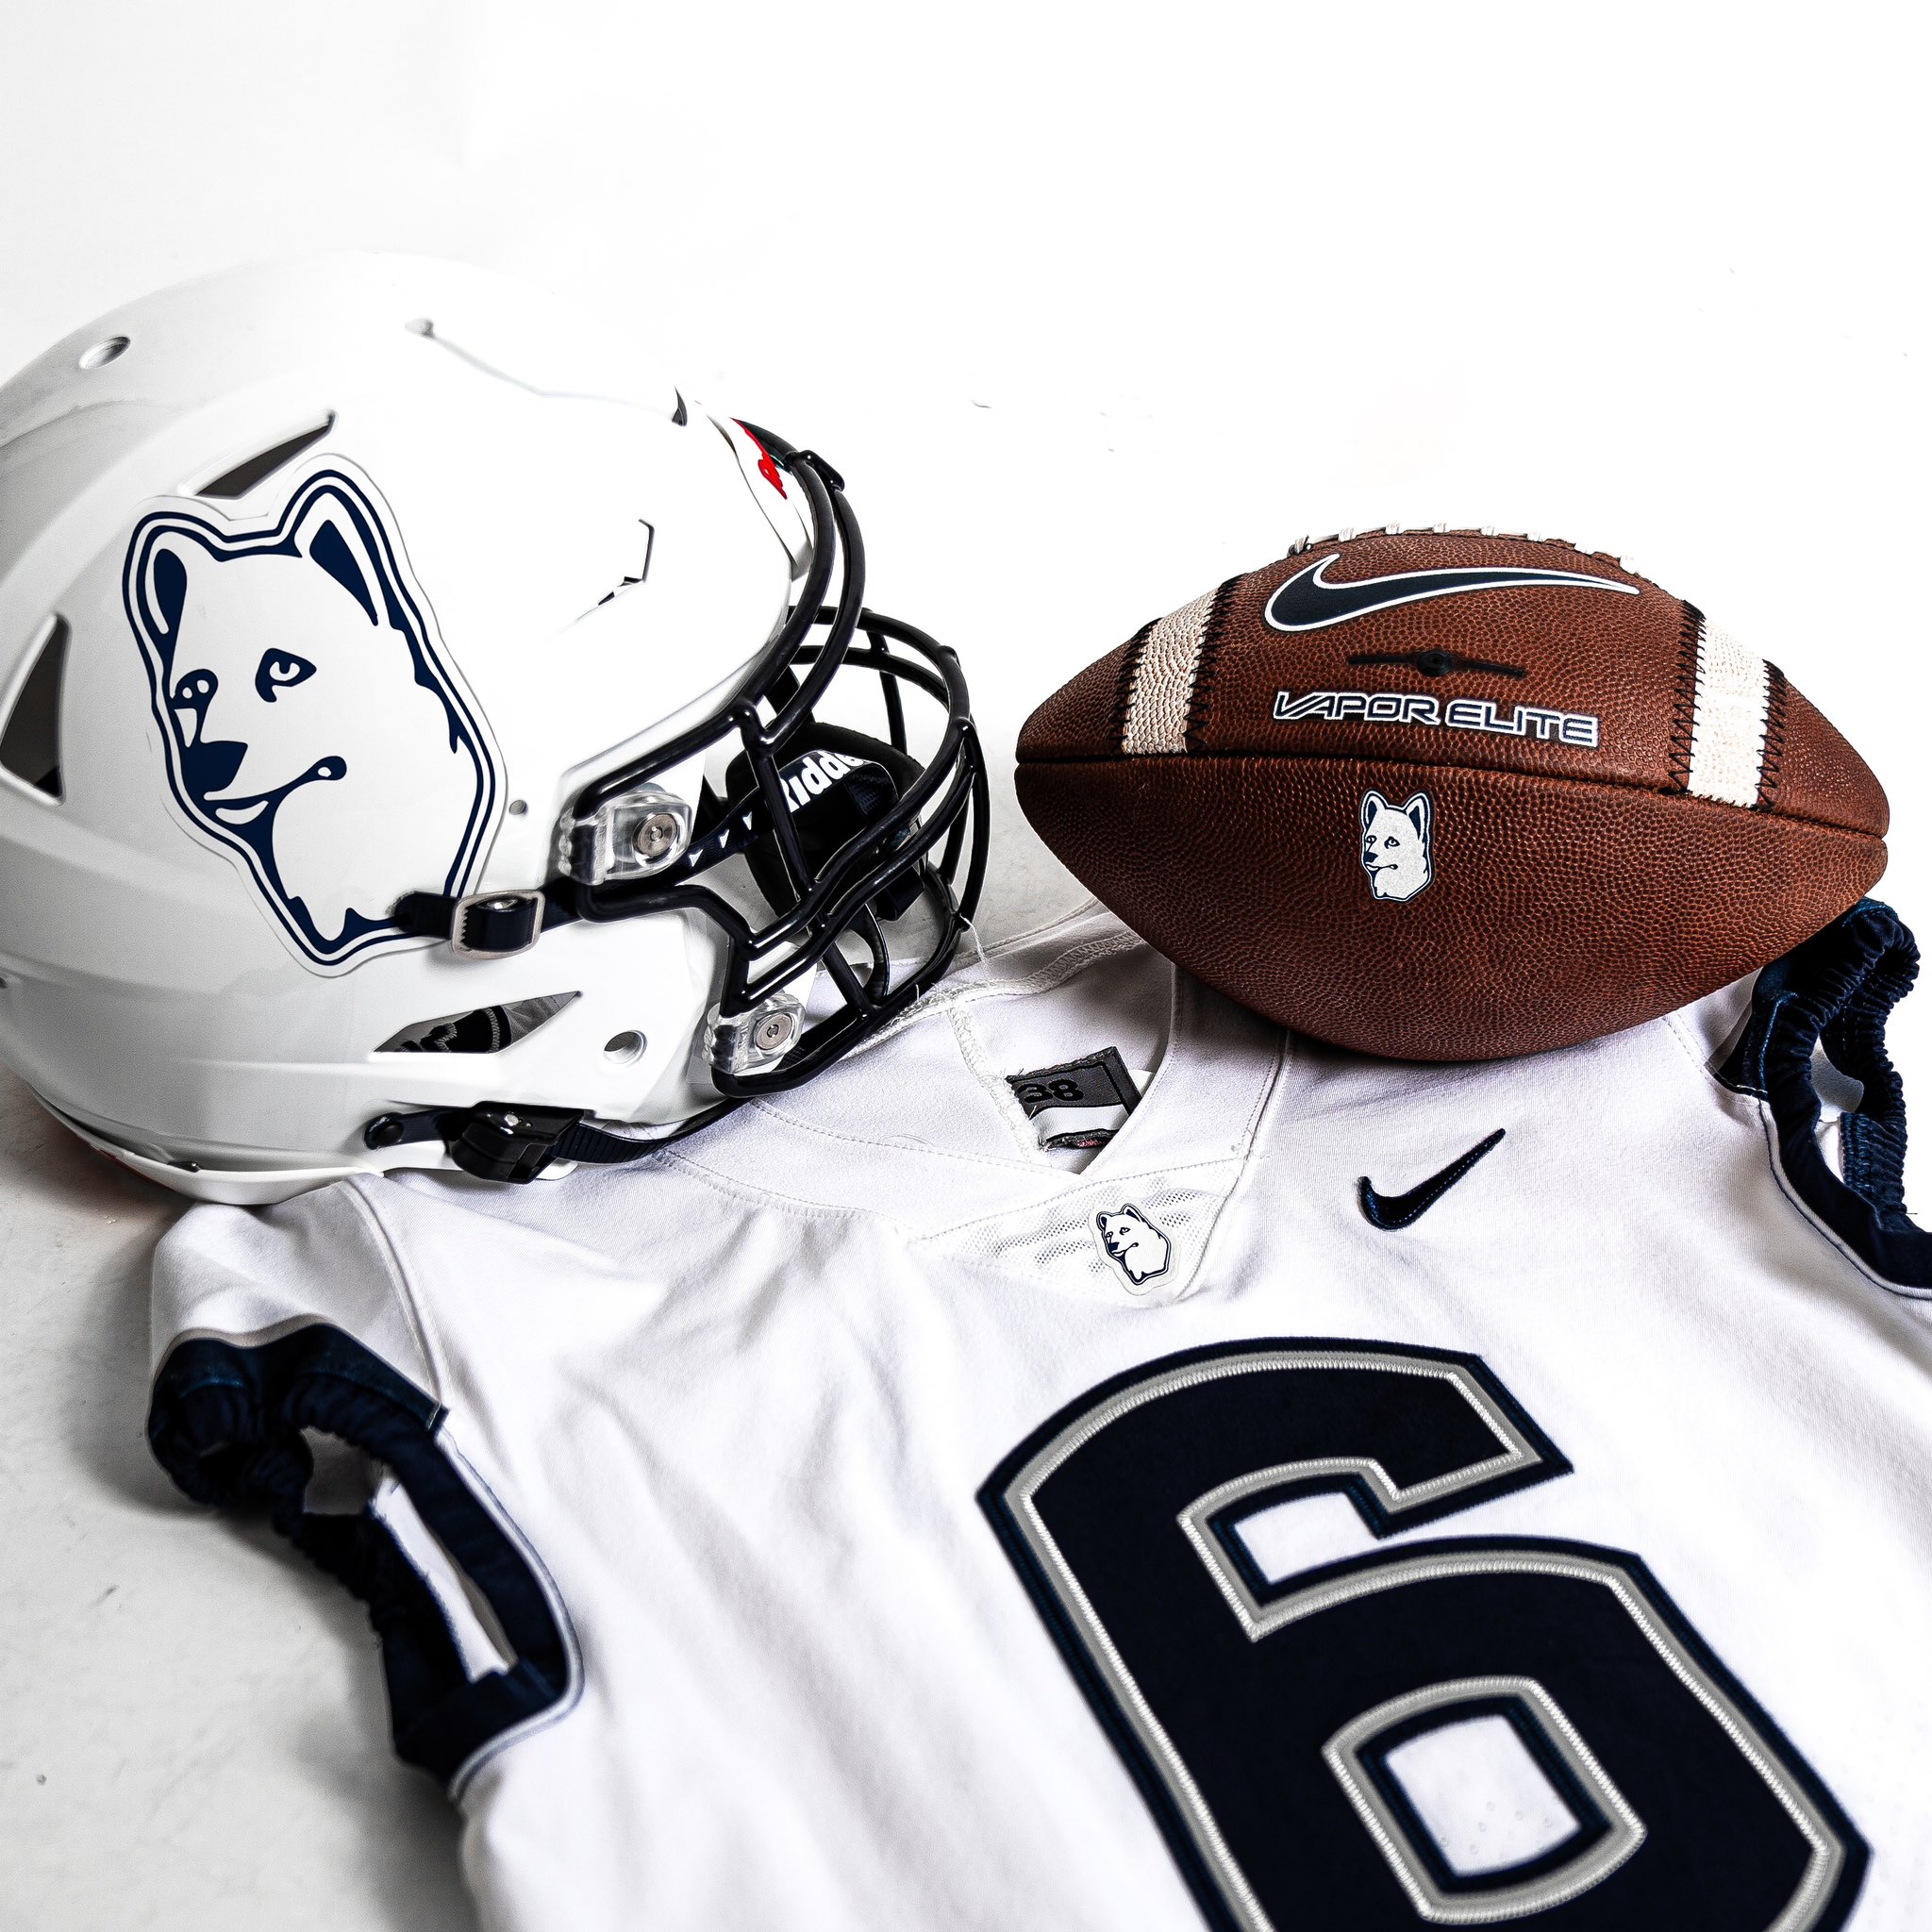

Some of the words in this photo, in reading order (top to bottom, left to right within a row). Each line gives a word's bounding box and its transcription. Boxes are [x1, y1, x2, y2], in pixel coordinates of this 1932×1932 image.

[1273, 691, 1441, 725] VAPOR
[1444, 699, 1599, 748] ELITE
[1017, 1079, 1084, 1104] 38
[976, 1336, 1871, 1932] 6
